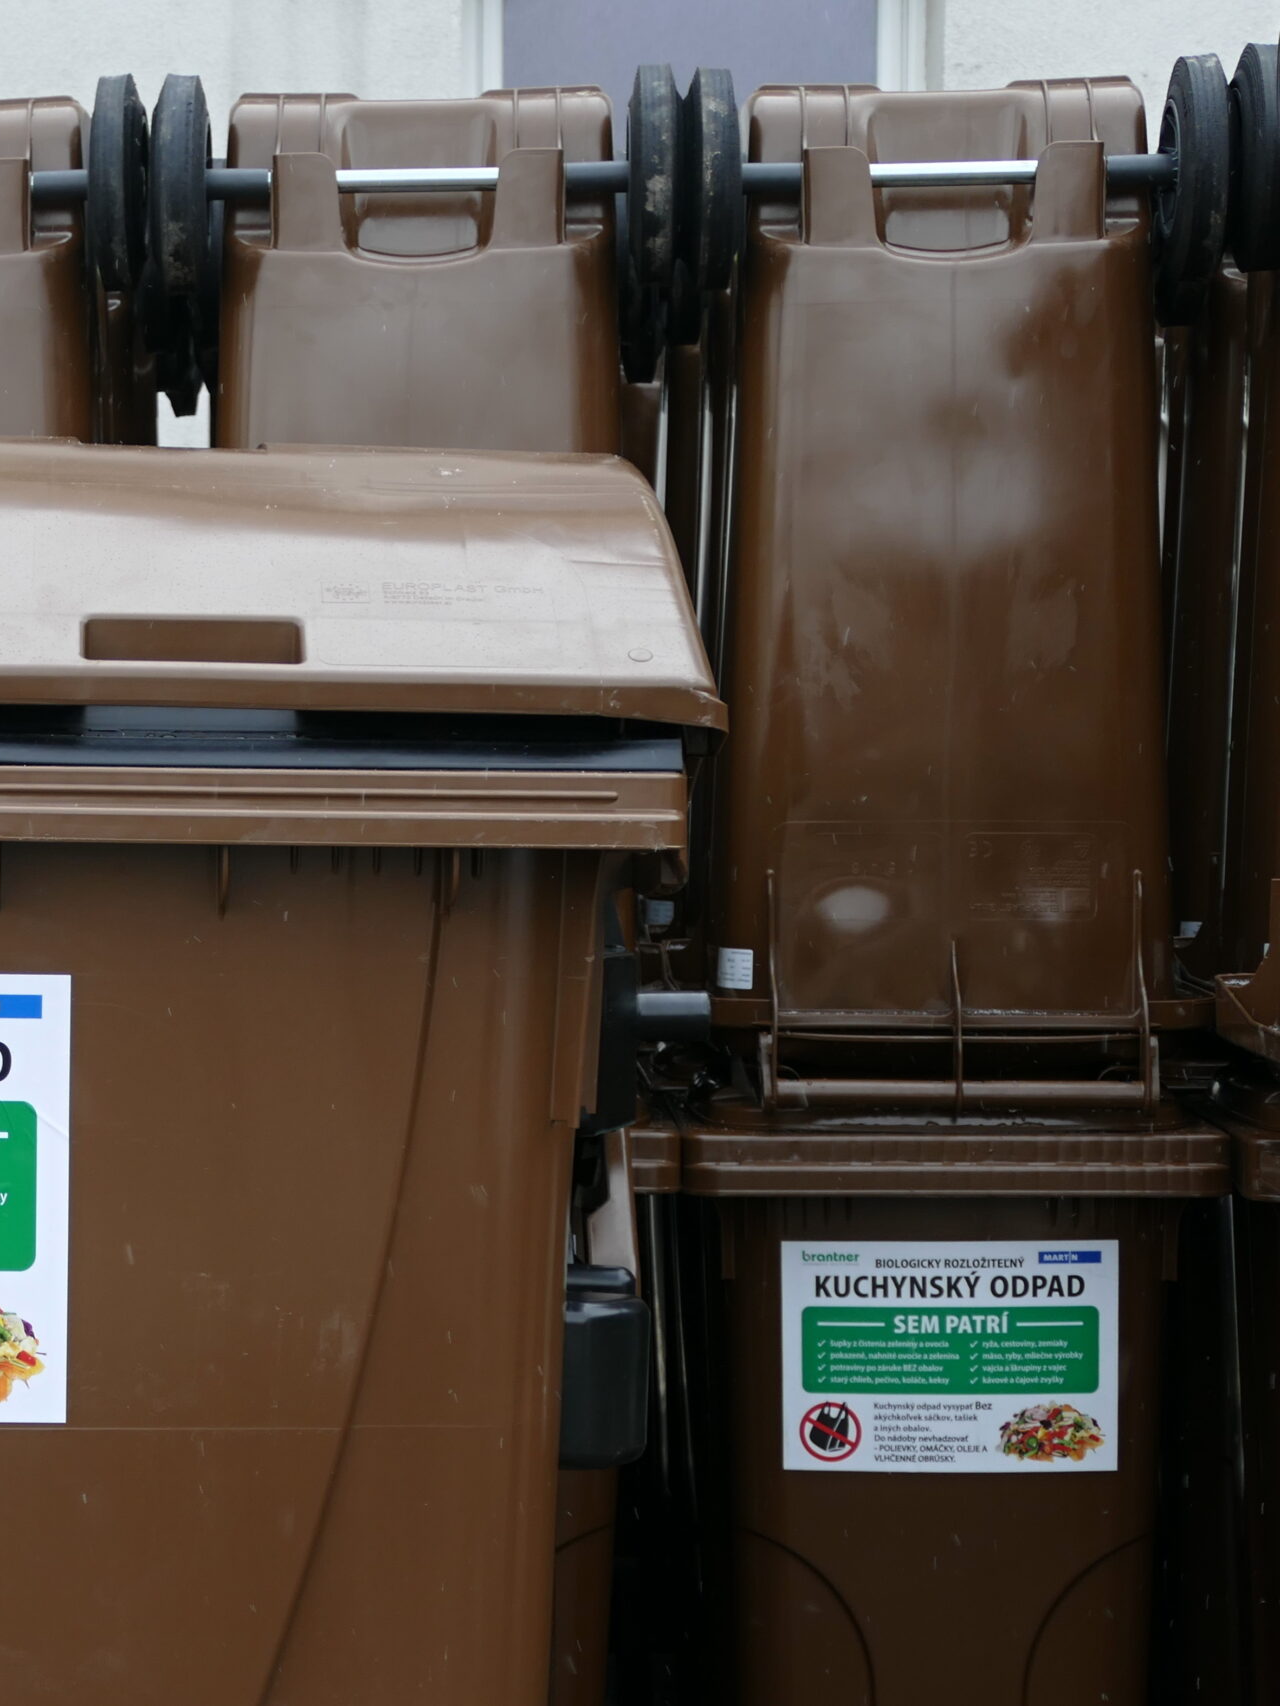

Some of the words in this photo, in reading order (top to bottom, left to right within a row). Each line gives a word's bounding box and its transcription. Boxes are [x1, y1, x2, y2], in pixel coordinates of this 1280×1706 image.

[802, 1250, 860, 1262] brantner
[875, 1258, 941, 1268] BIOLOGICKY
[944, 1256, 1024, 1268] ROZLOŽITEĽNÝ
[815, 1272, 980, 1299] KUCHYNSKÝ
[989, 1274, 1085, 1298] ODPAD
[893, 1314, 939, 1333] SEM
[945, 1311, 1009, 1333] PATRÍ
